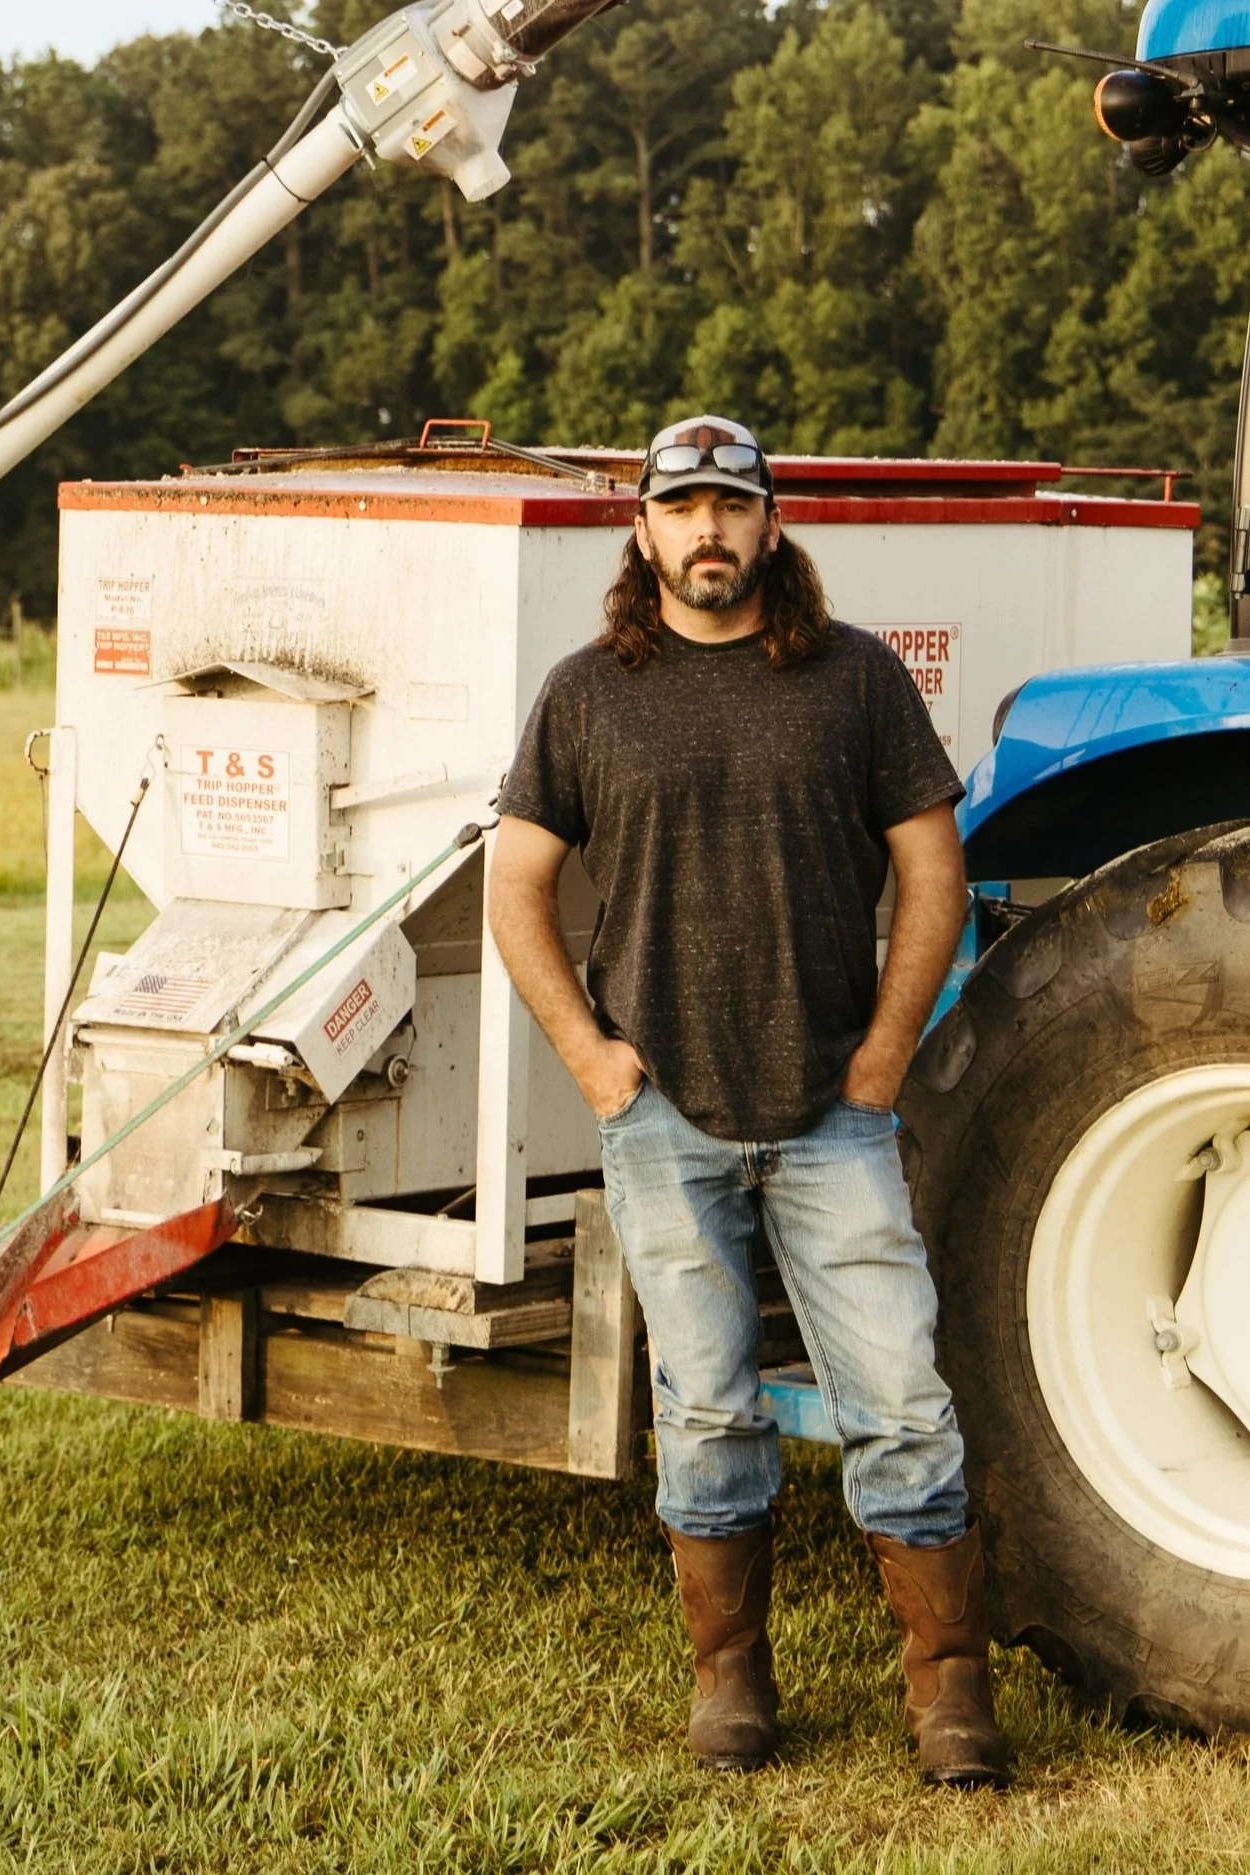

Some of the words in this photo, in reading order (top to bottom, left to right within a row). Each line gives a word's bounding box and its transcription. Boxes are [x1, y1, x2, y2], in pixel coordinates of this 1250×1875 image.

[98, 579, 116, 591] TRIP
[118, 580, 150, 592] HOPPER
[196, 750, 214, 776] T
[226, 752, 245, 778] &
[257, 754, 275, 779] S
[196, 778, 222, 791] TRIP
[184, 793, 214, 806] FEED
[218, 796, 287, 812] DISPENSER
[326, 983, 369, 1037] DANGER
[335, 1030, 356, 1056] KEEP
[355, 1000, 381, 1031] CLEAR
